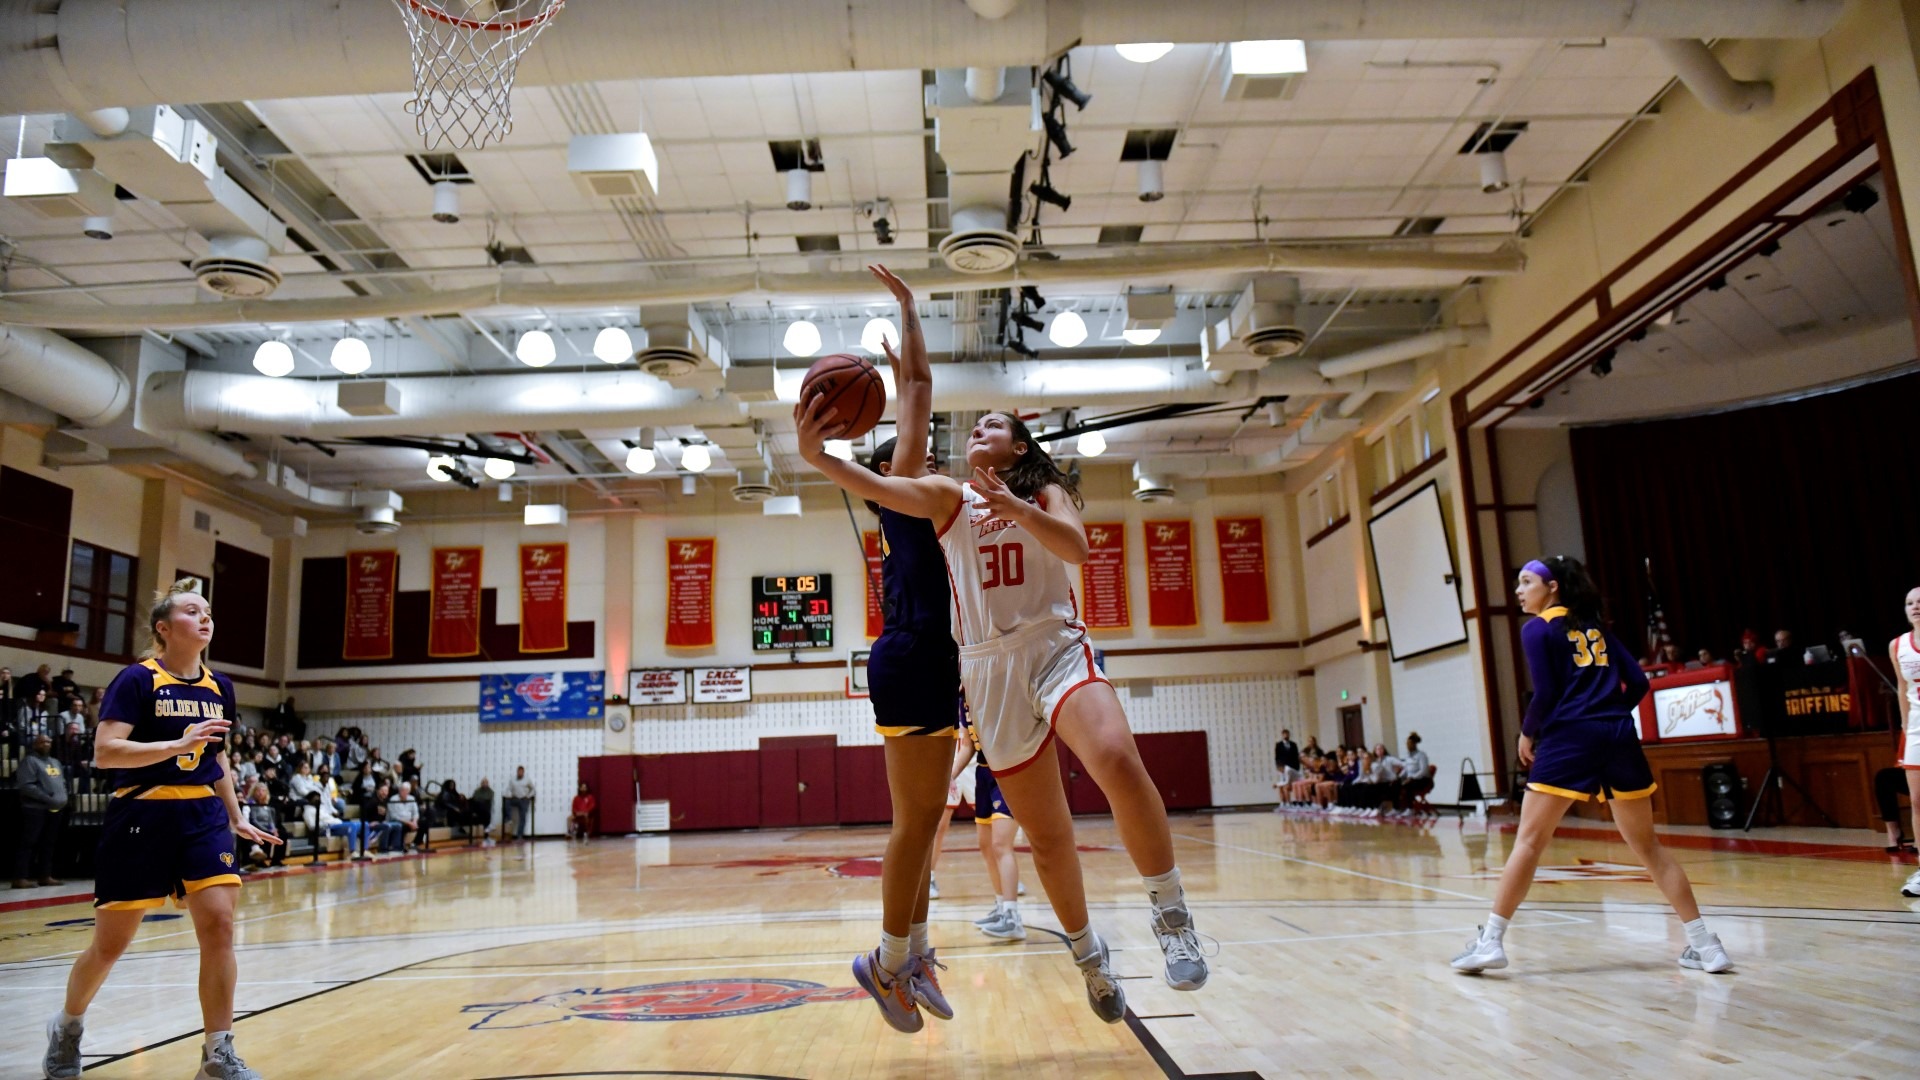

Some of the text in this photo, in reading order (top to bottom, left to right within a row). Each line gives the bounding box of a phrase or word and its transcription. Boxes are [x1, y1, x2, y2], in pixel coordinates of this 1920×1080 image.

[979, 542, 1024, 590] 30
[760, 601, 778, 617] 41
[809, 600, 828, 615] 37
[788, 610, 797, 622] 4
[802, 615, 832, 623] VISITOR
[1567, 628, 1609, 667] 32
[642, 672, 674, 681] CACC
[706, 670, 738, 679] CACC
[515, 682, 554, 696] CACC
[155, 699, 224, 719] GOLDEN RAMS
